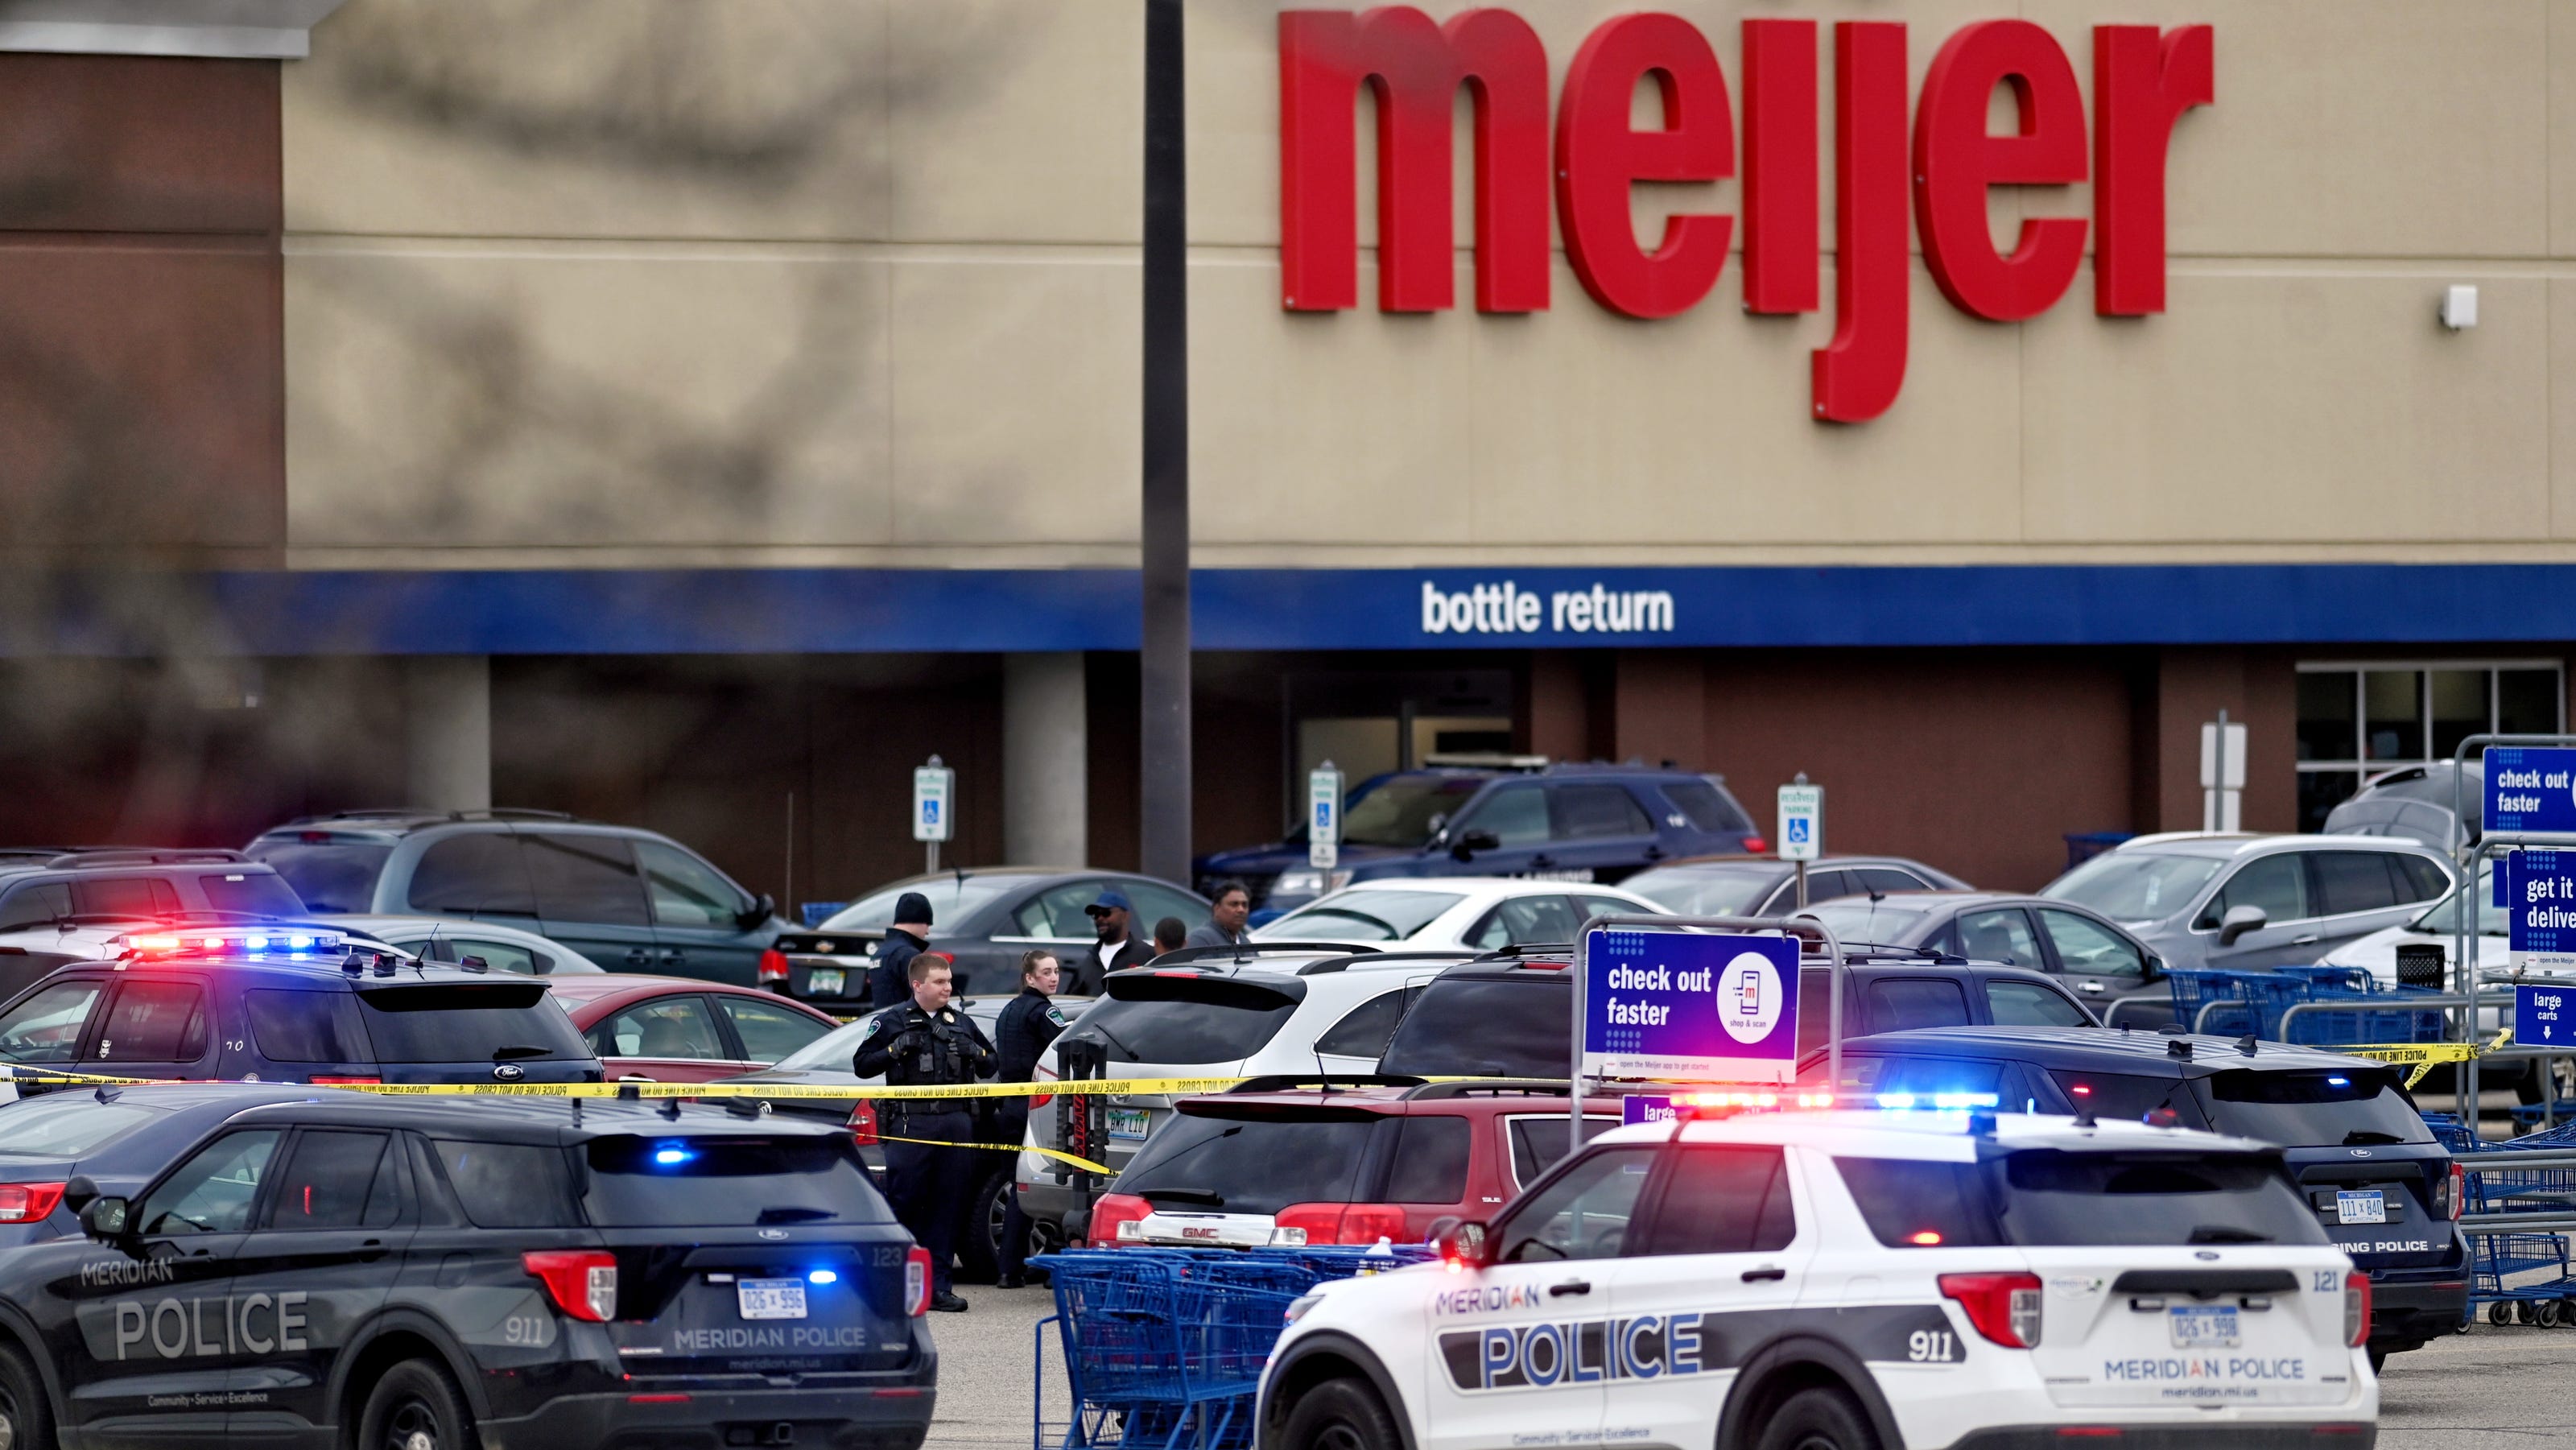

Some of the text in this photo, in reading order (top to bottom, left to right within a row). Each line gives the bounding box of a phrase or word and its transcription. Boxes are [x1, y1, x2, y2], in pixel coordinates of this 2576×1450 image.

[1278, 4, 2215, 423] meijer
[1422, 580, 1674, 634] bottle return
[2498, 768, 2569, 789] check out
[2497, 791, 2541, 812] faster
[2527, 876, 2574, 903] get it
[1608, 963, 1712, 992] check out
[1744, 987, 1755, 998] m
[2534, 992, 2562, 1010] large
[1607, 997, 1670, 1026] faster
[2537, 1010, 2557, 1021] carts
[1730, 1019, 1744, 1028] shop
[1745, 1019, 1751, 1027] &
[1645, 1061, 1662, 1070] Meijer
[2389, 1051, 2402, 1061] LINE
[2405, 1050, 2427, 1060] POLICE
[502, 1068, 518, 1076] Ford
[1644, 1103, 1676, 1122] large
[1073, 1093, 1085, 1172] AKIM
[2341, 1200, 2357, 1217] 111
[2367, 1200, 2383, 1215] 840
[1183, 1227, 1219, 1239] GMC
[873, 1248, 902, 1266] 123
[2375, 1241, 2429, 1252] POLICE
[80, 1256, 175, 1287] MERIDIAN
[2313, 1271, 2339, 1291] 121
[1436, 1283, 1542, 1316] MERIDIAN
[116, 1291, 308, 1361] POLICE
[506, 1316, 543, 1345] 911
[675, 1327, 866, 1349] MERIDIAN POLICE
[1909, 1330, 1953, 1361] 911
[1480, 1313, 1704, 1389] POLICE
[2104, 1358, 2305, 1380] MERIDIAN POLICE
[2161, 1386, 2259, 1398] meridian.mi.us
